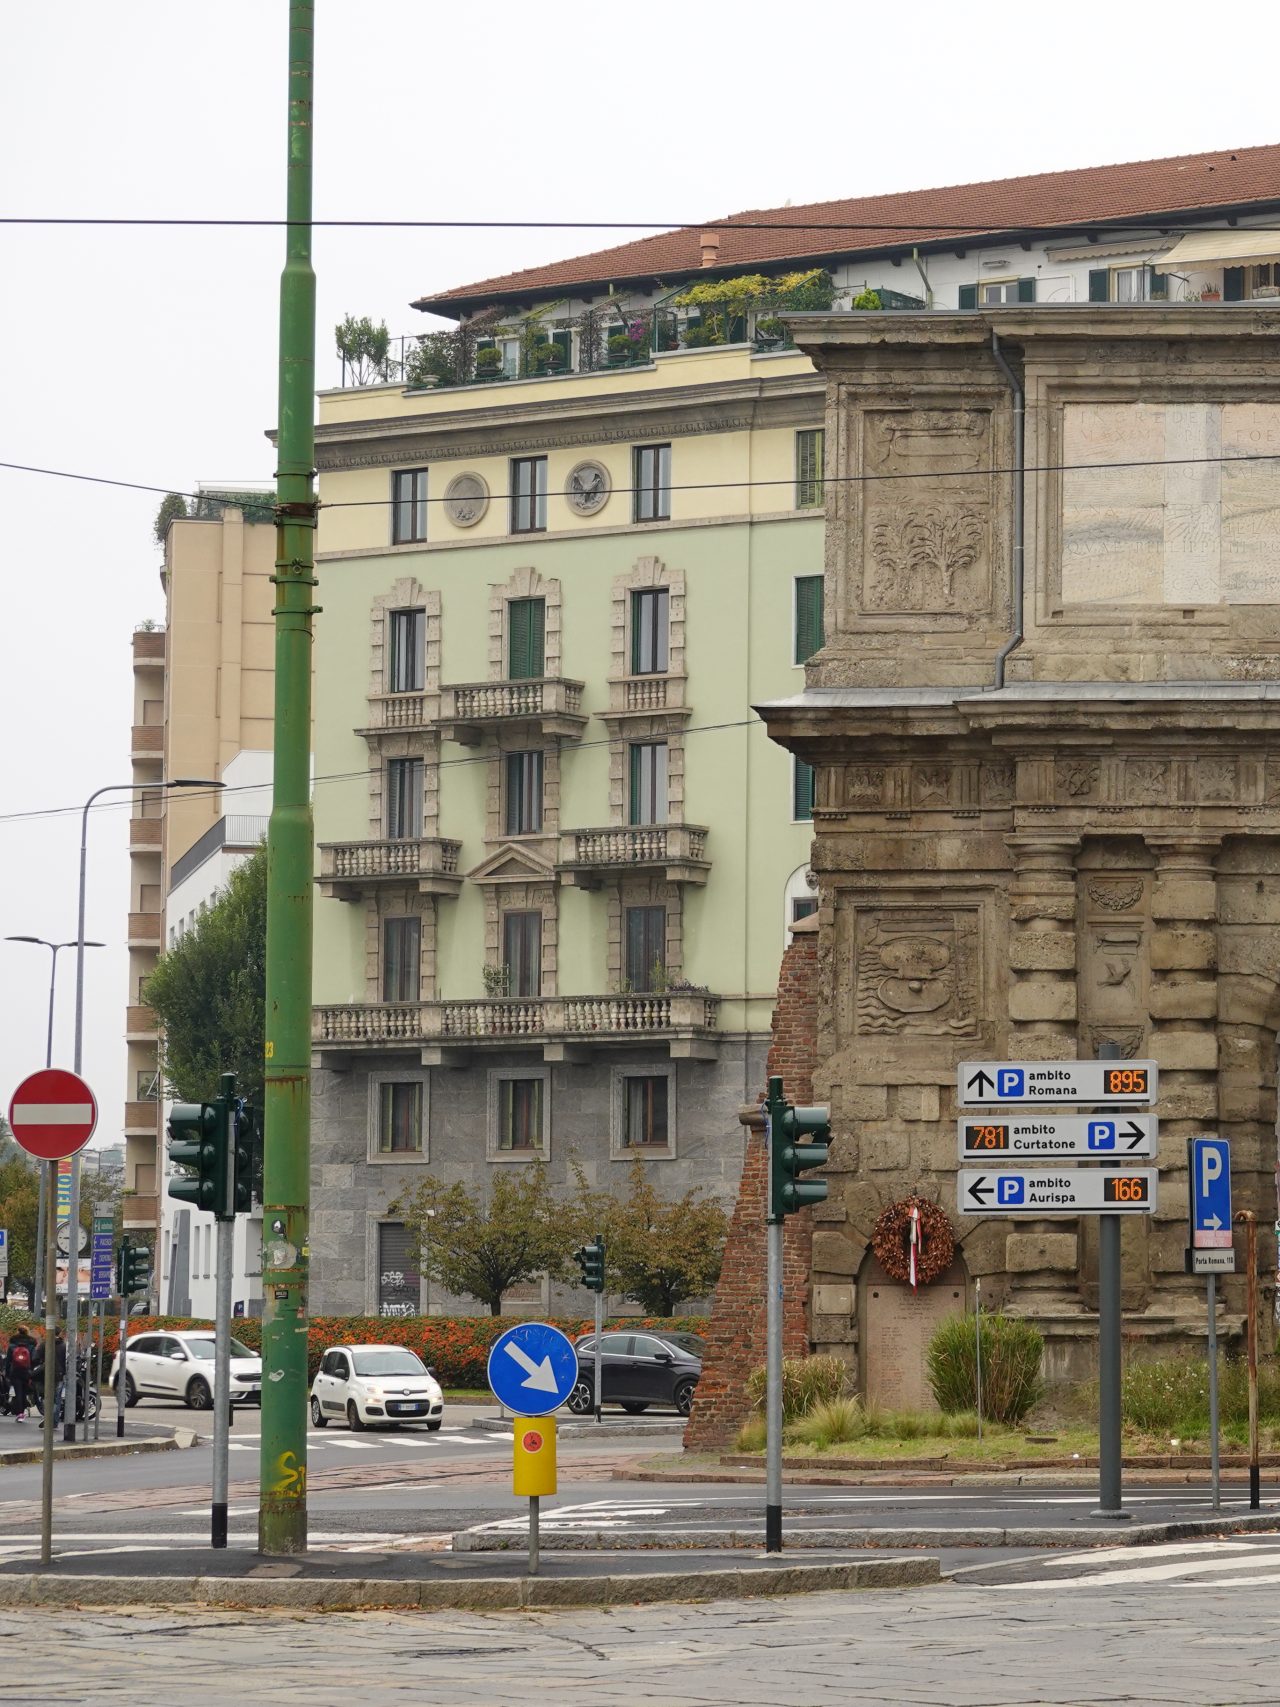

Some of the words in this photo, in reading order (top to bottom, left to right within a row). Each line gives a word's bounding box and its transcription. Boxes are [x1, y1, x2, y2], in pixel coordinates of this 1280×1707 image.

[1003, 1073, 1020, 1093] P
[1029, 1070, 1071, 1081] ambito
[1109, 1070, 1145, 1093] 895
[1029, 1085, 1077, 1096] Romana
[973, 1126, 1004, 1149] 781
[1013, 1124, 1056, 1135] ambito
[1094, 1125, 1110, 1146] P
[1013, 1139, 1076, 1150] Curtatone
[1202, 1147, 1223, 1198] P
[1004, 1180, 1020, 1201] P
[1029, 1178, 1071, 1189] ambito
[1111, 1178, 1142, 1201] 166
[1029, 1192, 1076, 1205] Aurispa
[1195, 1256, 1207, 1265] Porta
